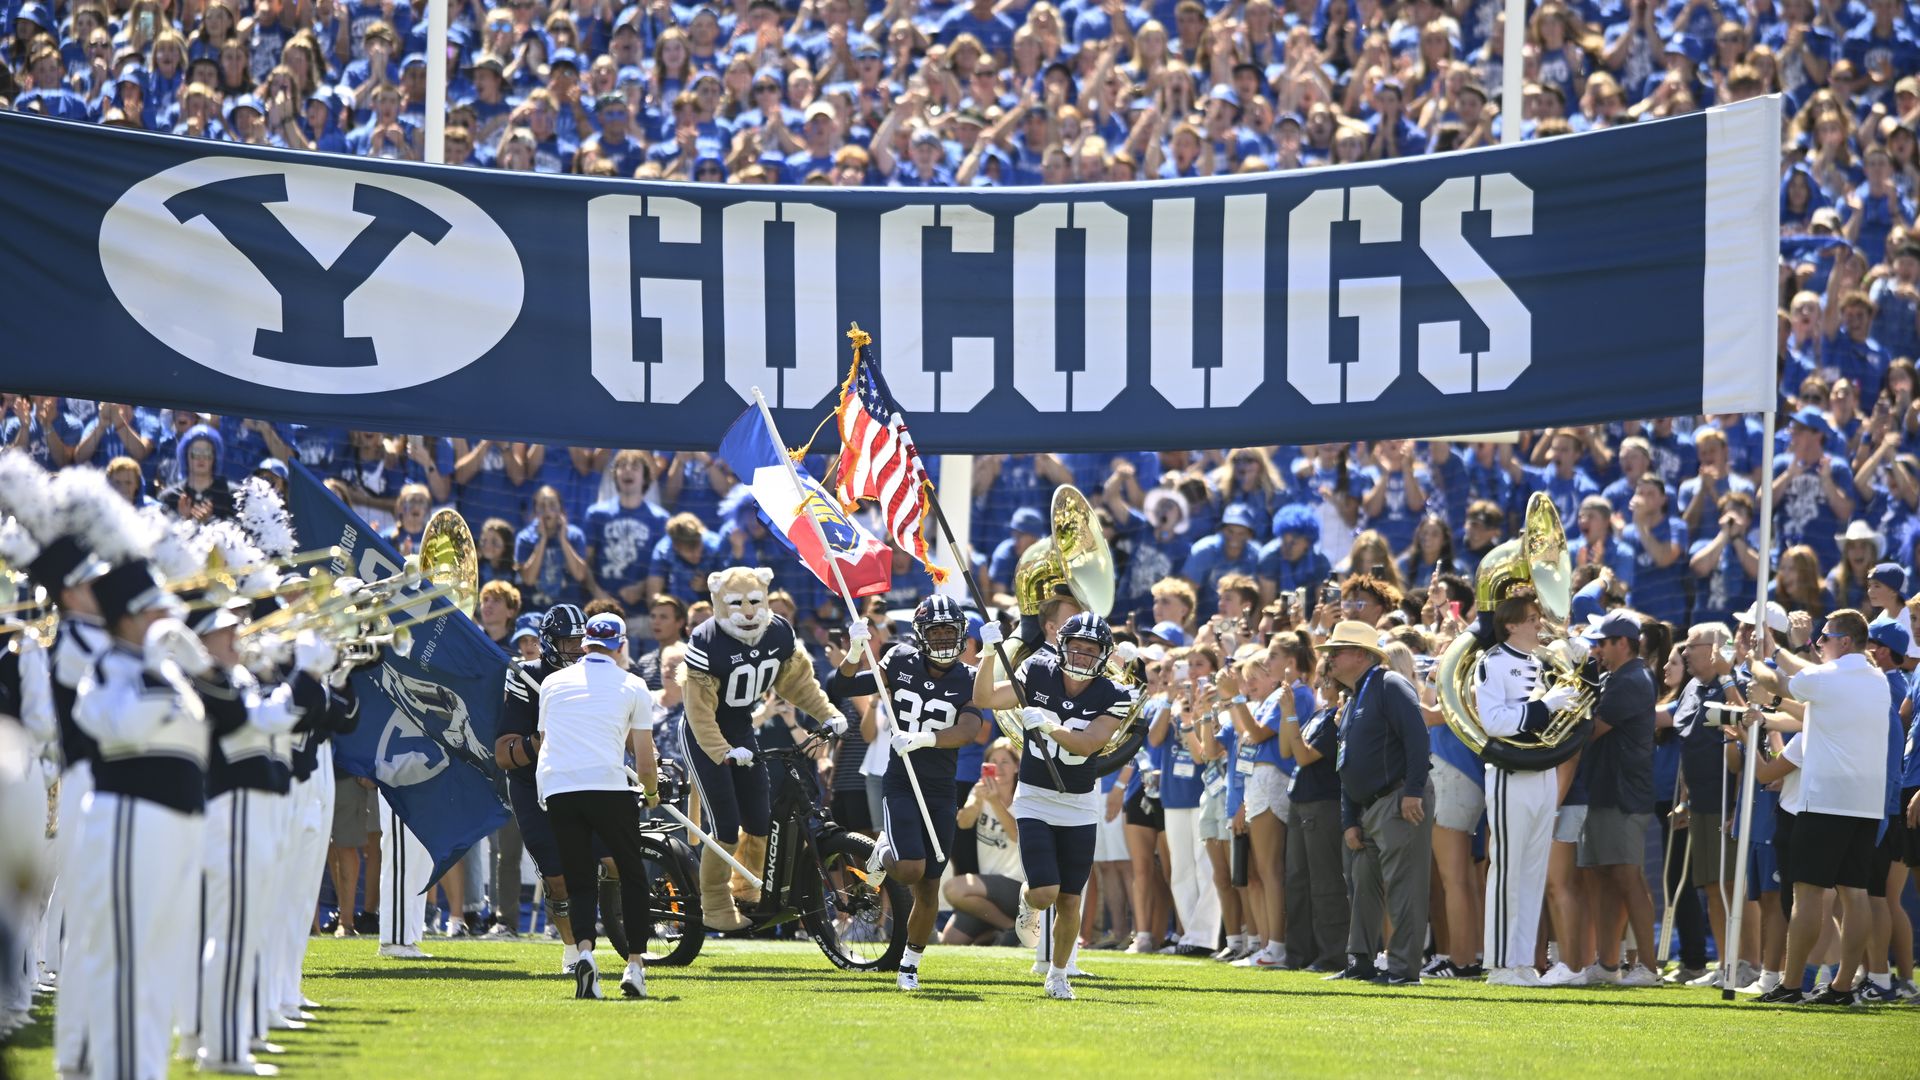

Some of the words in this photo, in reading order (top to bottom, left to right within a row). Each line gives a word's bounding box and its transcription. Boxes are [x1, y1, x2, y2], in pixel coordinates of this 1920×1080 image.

[162, 173, 453, 368] Y
[587, 193, 838, 411] GO
[879, 172, 1534, 413] COUGS
[725, 658, 781, 708] 00
[894, 688, 957, 733] 32
[766, 820, 780, 892] BAKCOU
